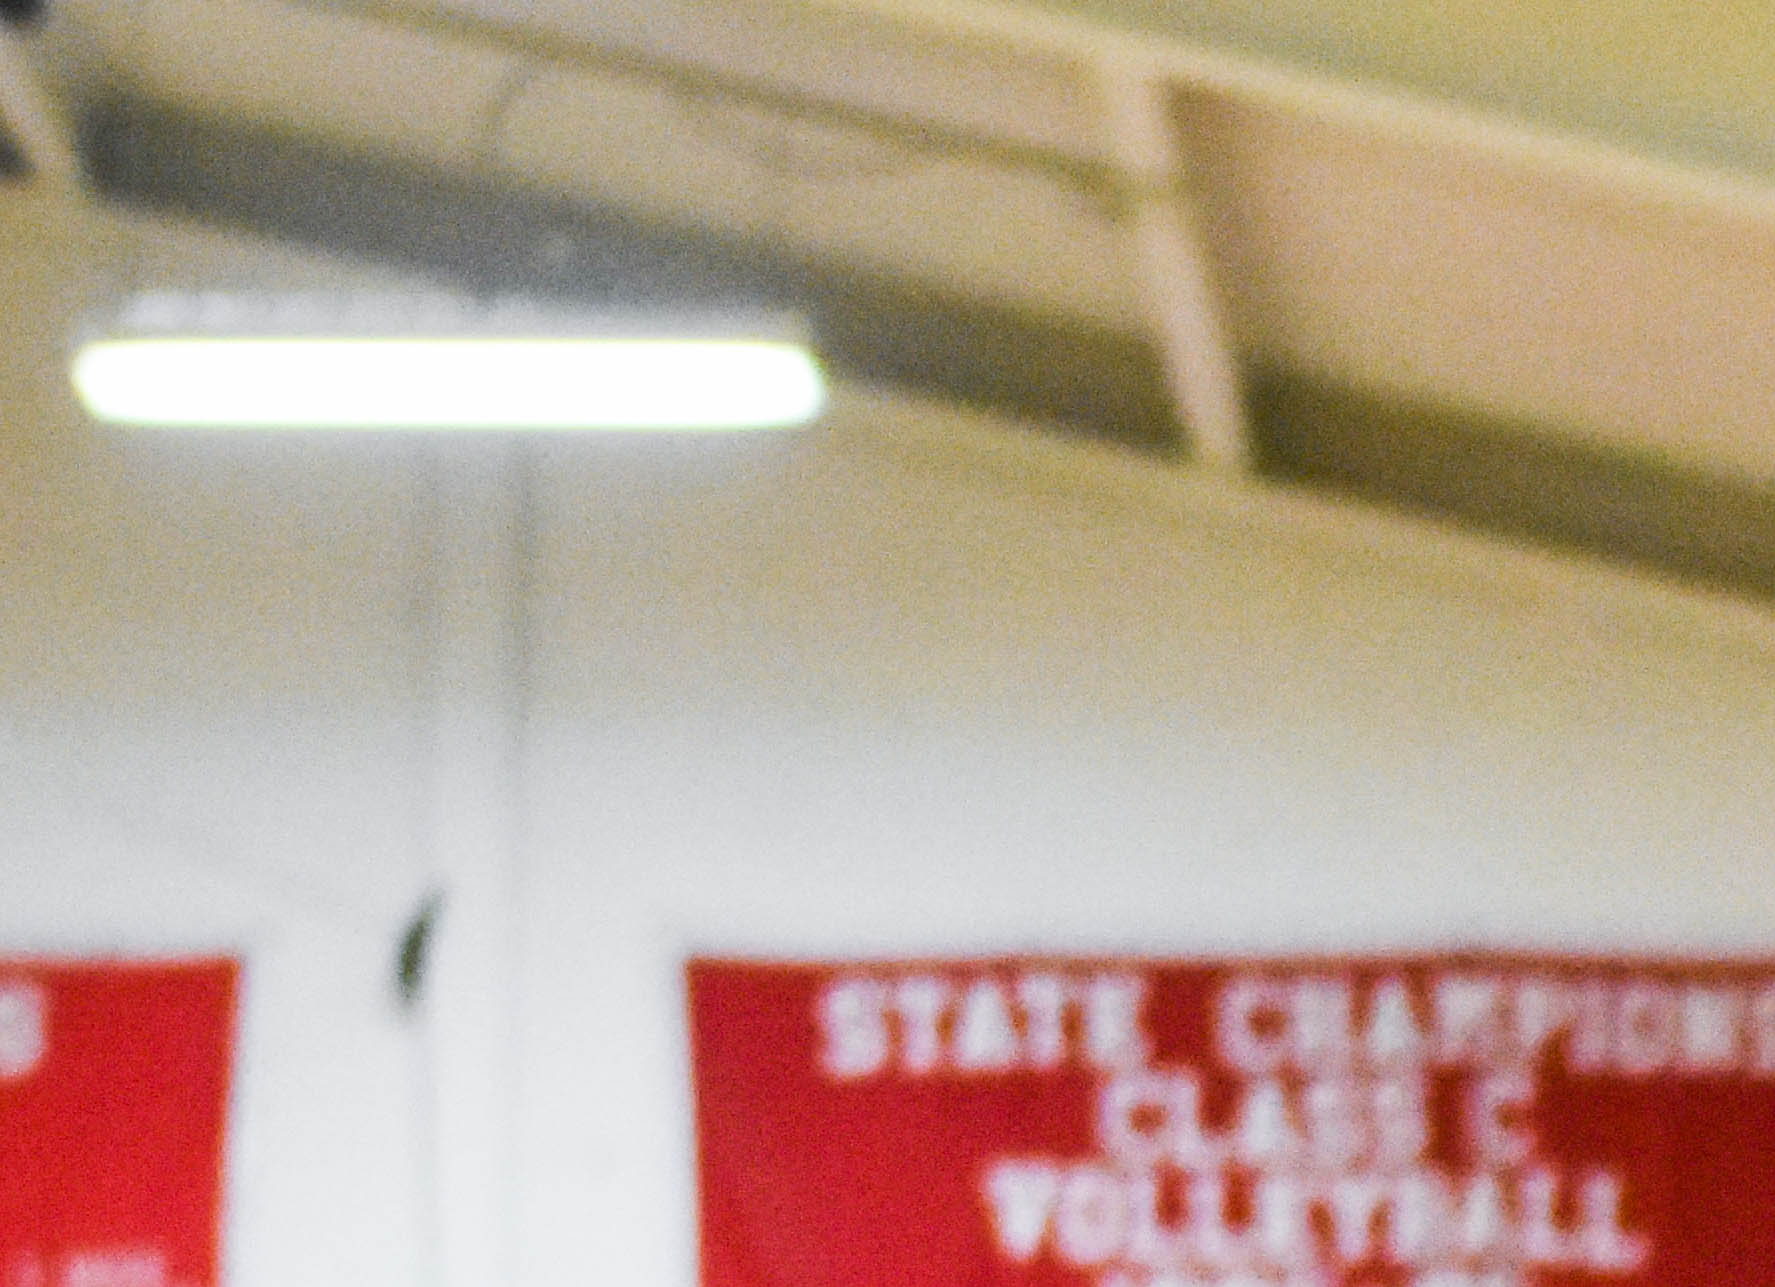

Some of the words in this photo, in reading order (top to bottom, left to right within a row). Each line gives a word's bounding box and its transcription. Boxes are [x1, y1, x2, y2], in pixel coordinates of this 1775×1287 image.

[819, 976, 1150, 1080] STATE
[1094, 1068, 1433, 1171] CLASS
[982, 1157, 1650, 1270] VOLLEYBALL
